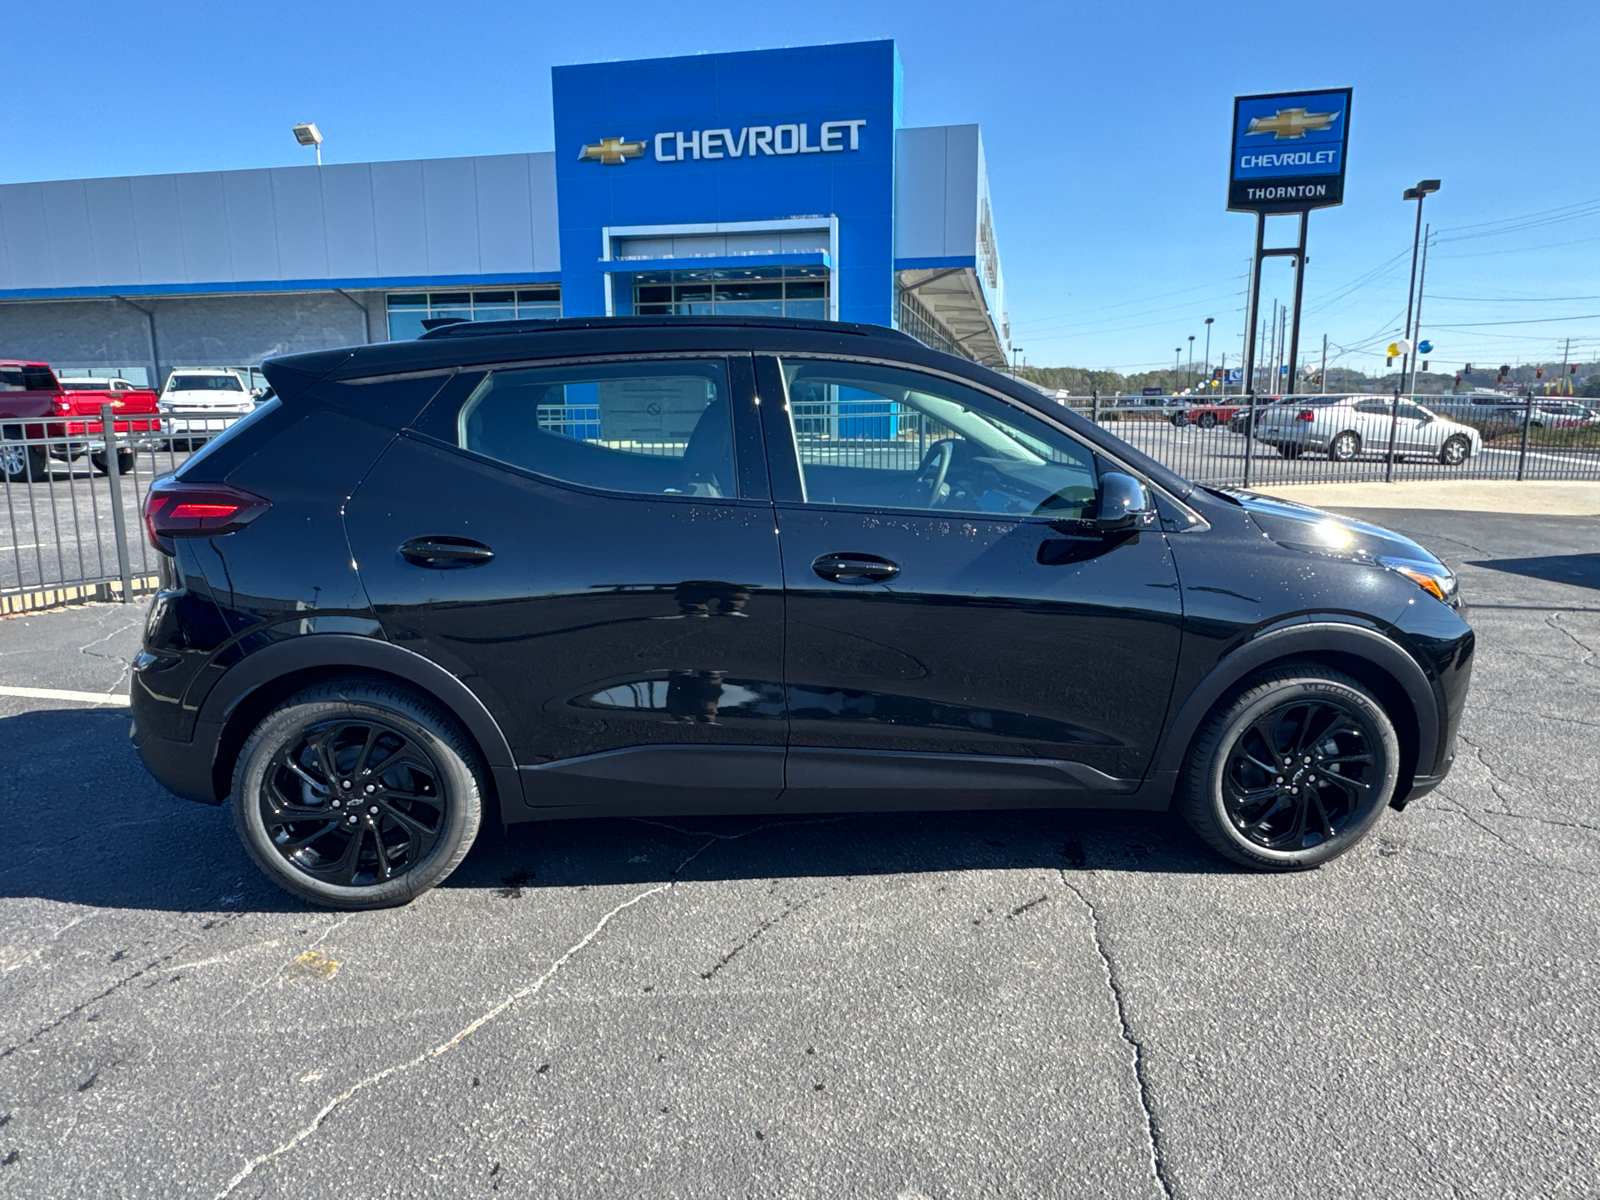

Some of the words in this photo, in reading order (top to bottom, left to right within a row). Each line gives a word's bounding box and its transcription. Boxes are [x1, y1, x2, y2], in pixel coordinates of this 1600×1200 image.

[654, 119, 867, 162] CHEVROLET
[1241, 150, 1336, 168] CHEVROLET
[1247, 184, 1326, 200] THORNTON
[1317, 684, 1364, 705] MICHELIN
